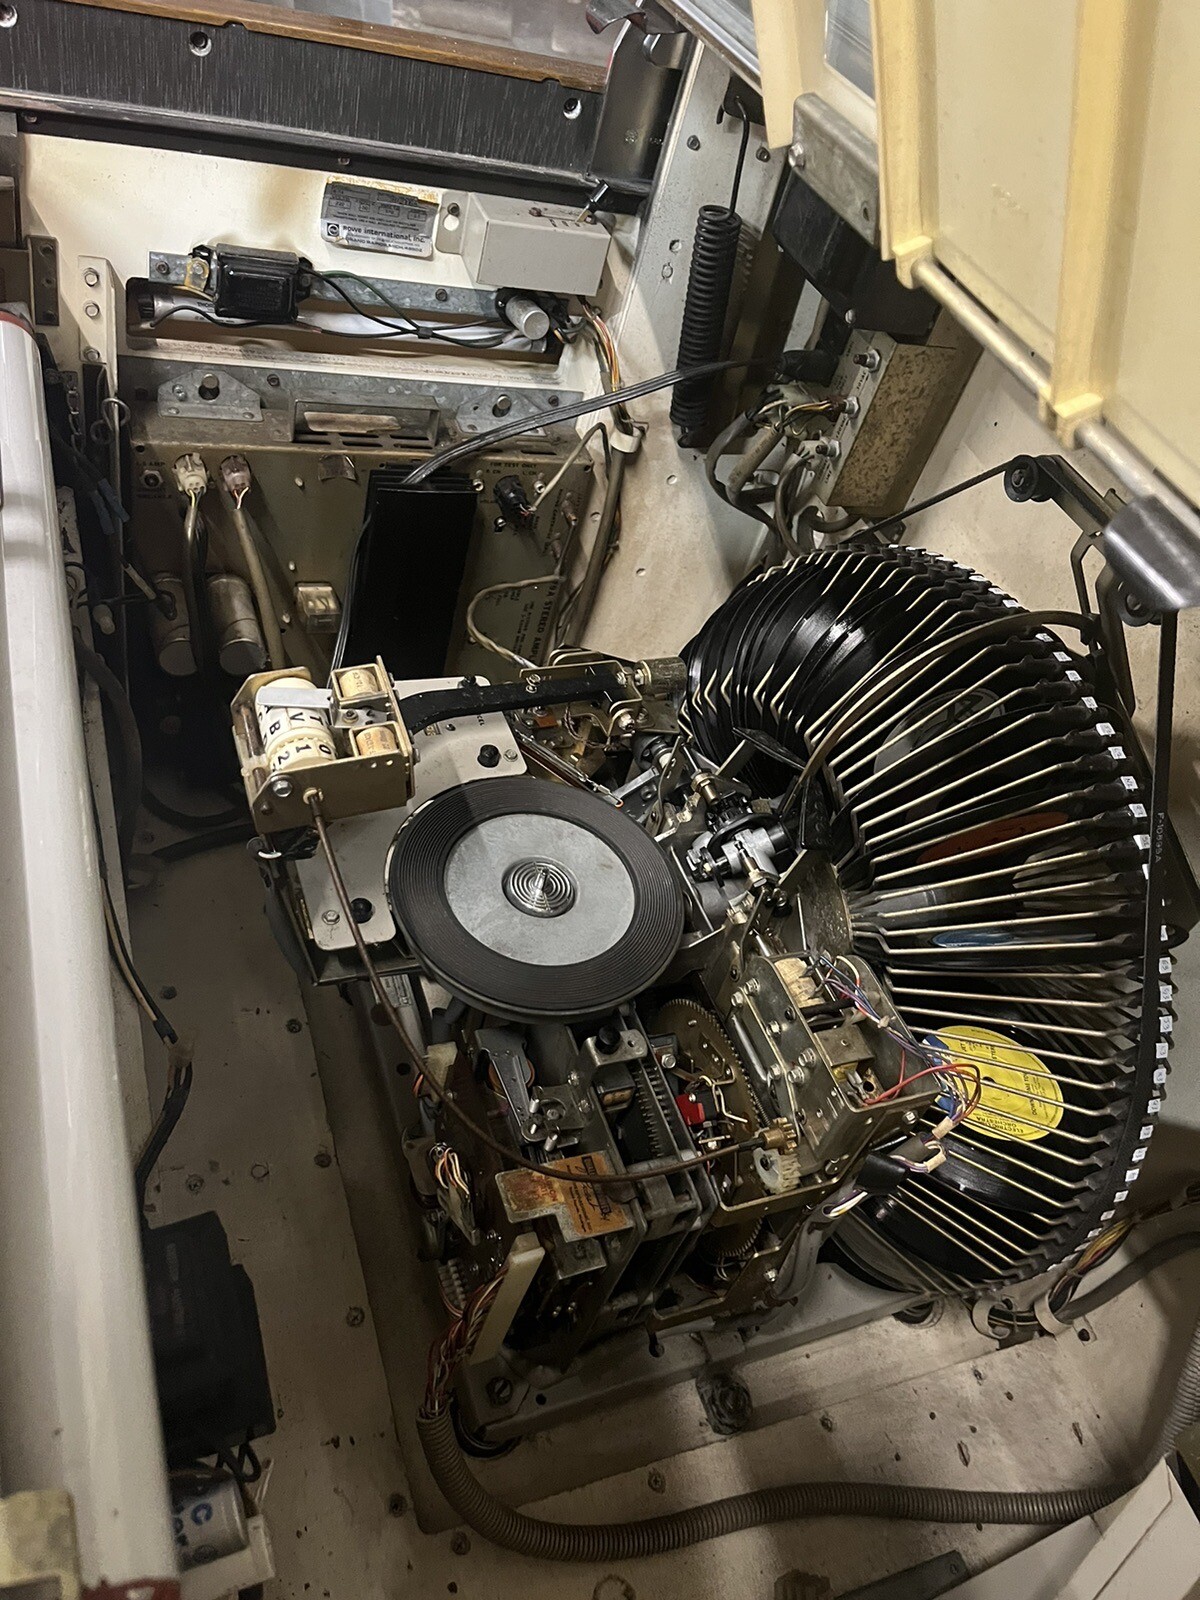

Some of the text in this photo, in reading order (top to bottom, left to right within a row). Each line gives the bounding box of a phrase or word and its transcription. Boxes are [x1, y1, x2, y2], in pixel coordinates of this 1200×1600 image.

[537, 601, 553, 634] STEREO
[290, 712, 306, 722] V
[269, 720, 282, 736] B
[295, 744, 312, 754] 1
[277, 751, 291, 765] 2
[976, 1115, 1017, 1128] ORCHESTRA
